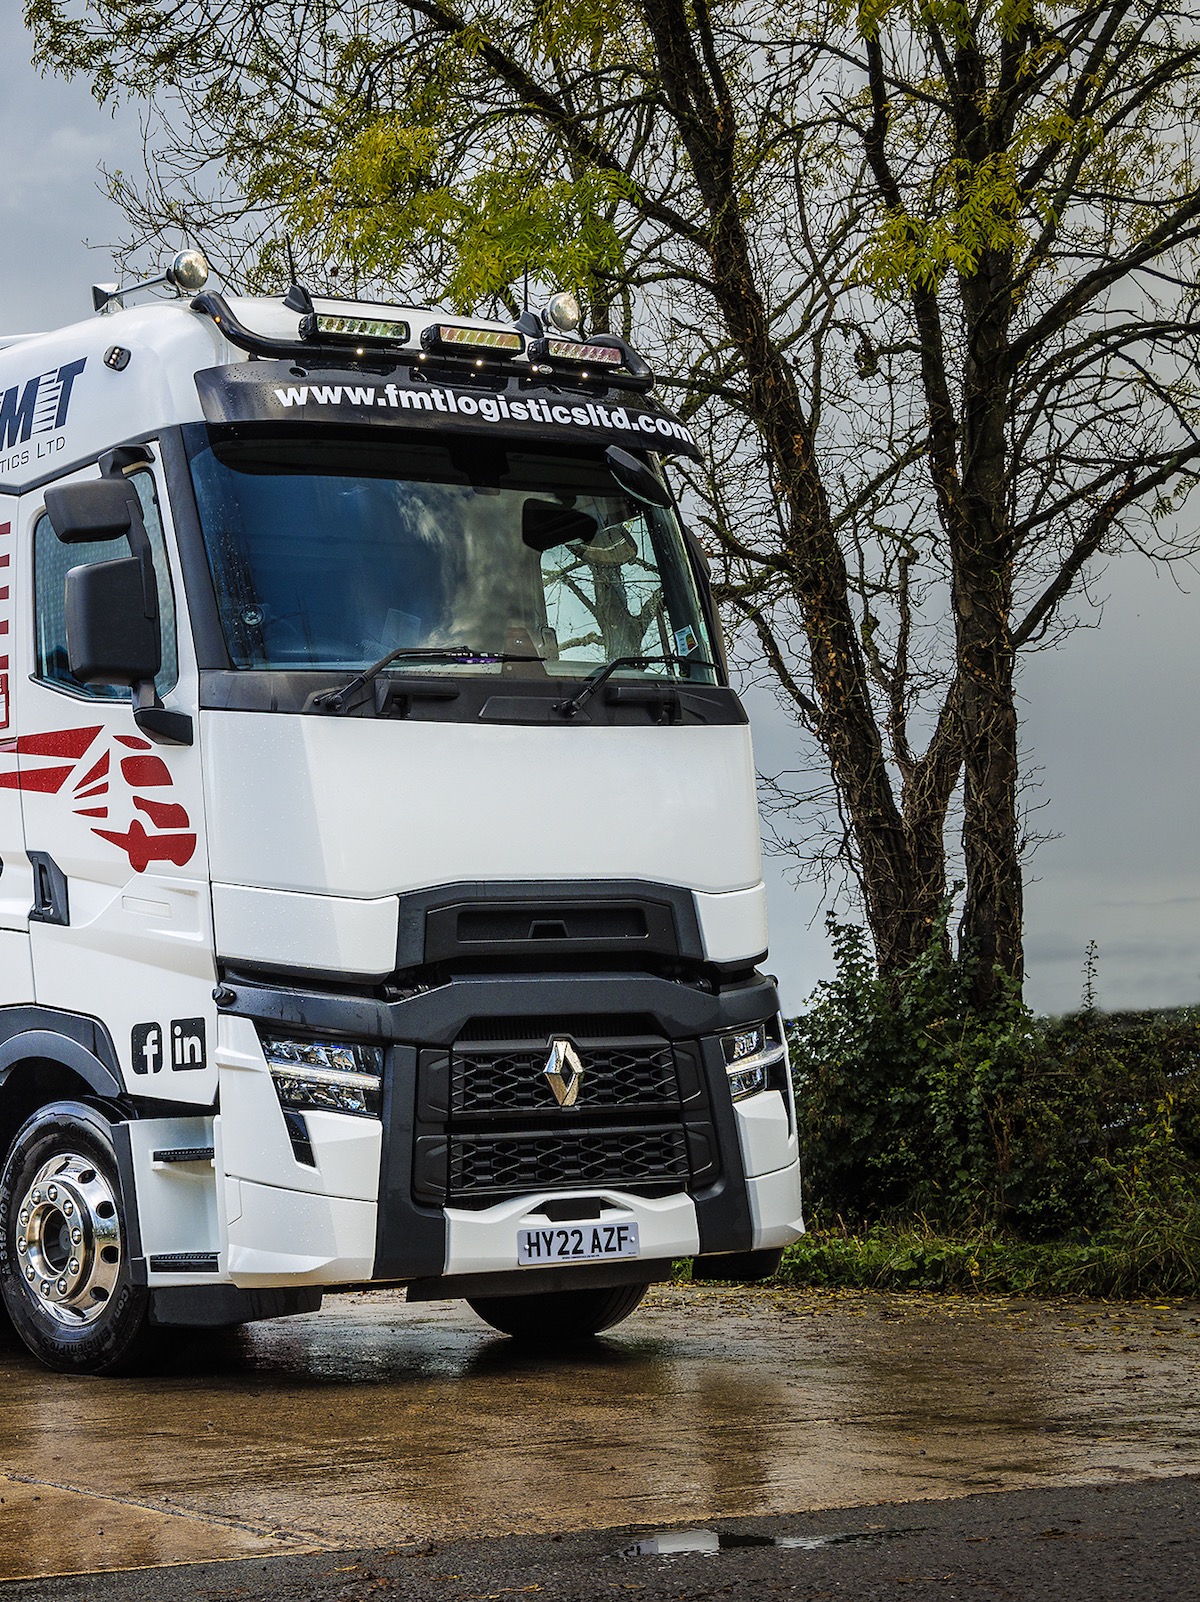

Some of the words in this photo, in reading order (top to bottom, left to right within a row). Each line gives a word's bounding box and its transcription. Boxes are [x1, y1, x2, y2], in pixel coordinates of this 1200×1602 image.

[275, 383, 695, 445] www.fmtlogisticsltd.com
[174, 1025, 203, 1065] in
[526, 1229, 584, 1257] HY22
[591, 1226, 629, 1254] AZF
